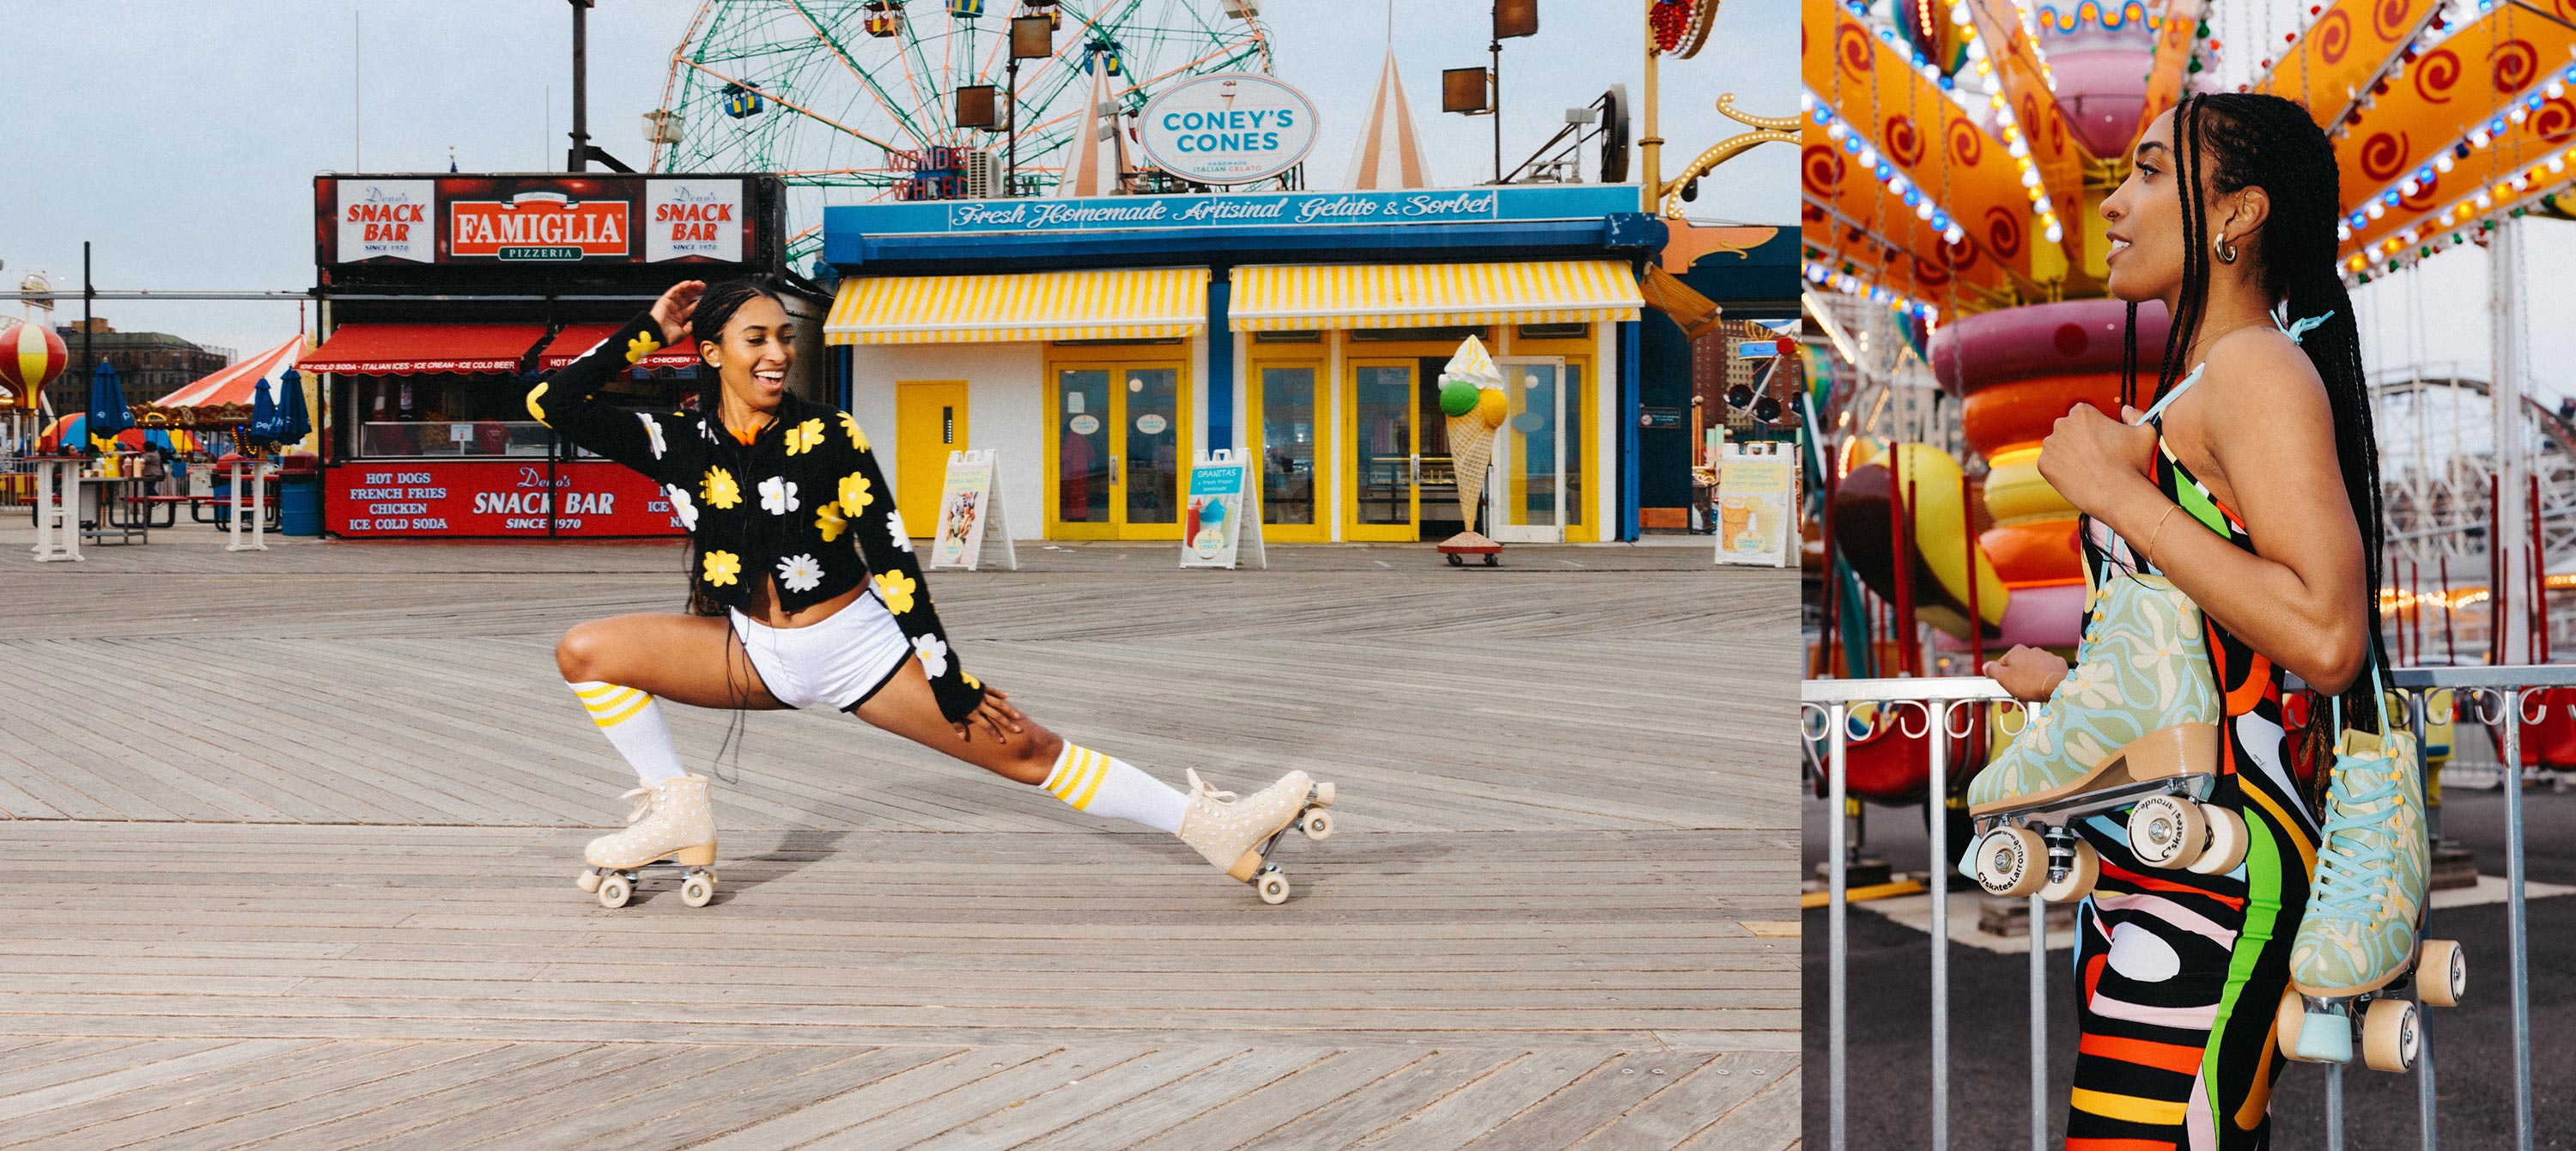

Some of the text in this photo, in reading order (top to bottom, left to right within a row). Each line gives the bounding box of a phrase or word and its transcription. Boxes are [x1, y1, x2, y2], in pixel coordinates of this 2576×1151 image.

[1163, 109, 1294, 131] CONEY'S
[1176, 131, 1279, 152] CONES
[366, 186, 408, 202] Deno's
[672, 186, 716, 202] Deno's
[347, 204, 427, 222] SNACK
[655, 203, 734, 222] SNACK
[952, 193, 1492, 228] Fresh Homemade Artisinal Gelato & Sorbet
[363, 223, 410, 241] BAR
[457, 214, 622, 243] FAMIGLIA
[671, 222, 718, 241] BAR
[509, 249, 573, 258] PIZZERIA
[550, 358, 567, 367] HOT
[366, 472, 431, 484] HOT DOGS
[1197, 469, 1236, 478] GRANITAS
[350, 487, 447, 499] FRENCH FRIES
[369, 502, 428, 515] CHICKEN
[564, 492, 616, 515] BAR
[647, 502, 669, 512] ICE
[349, 518, 448, 530] ICE COLD SODA
[506, 518, 547, 529] SINCE
